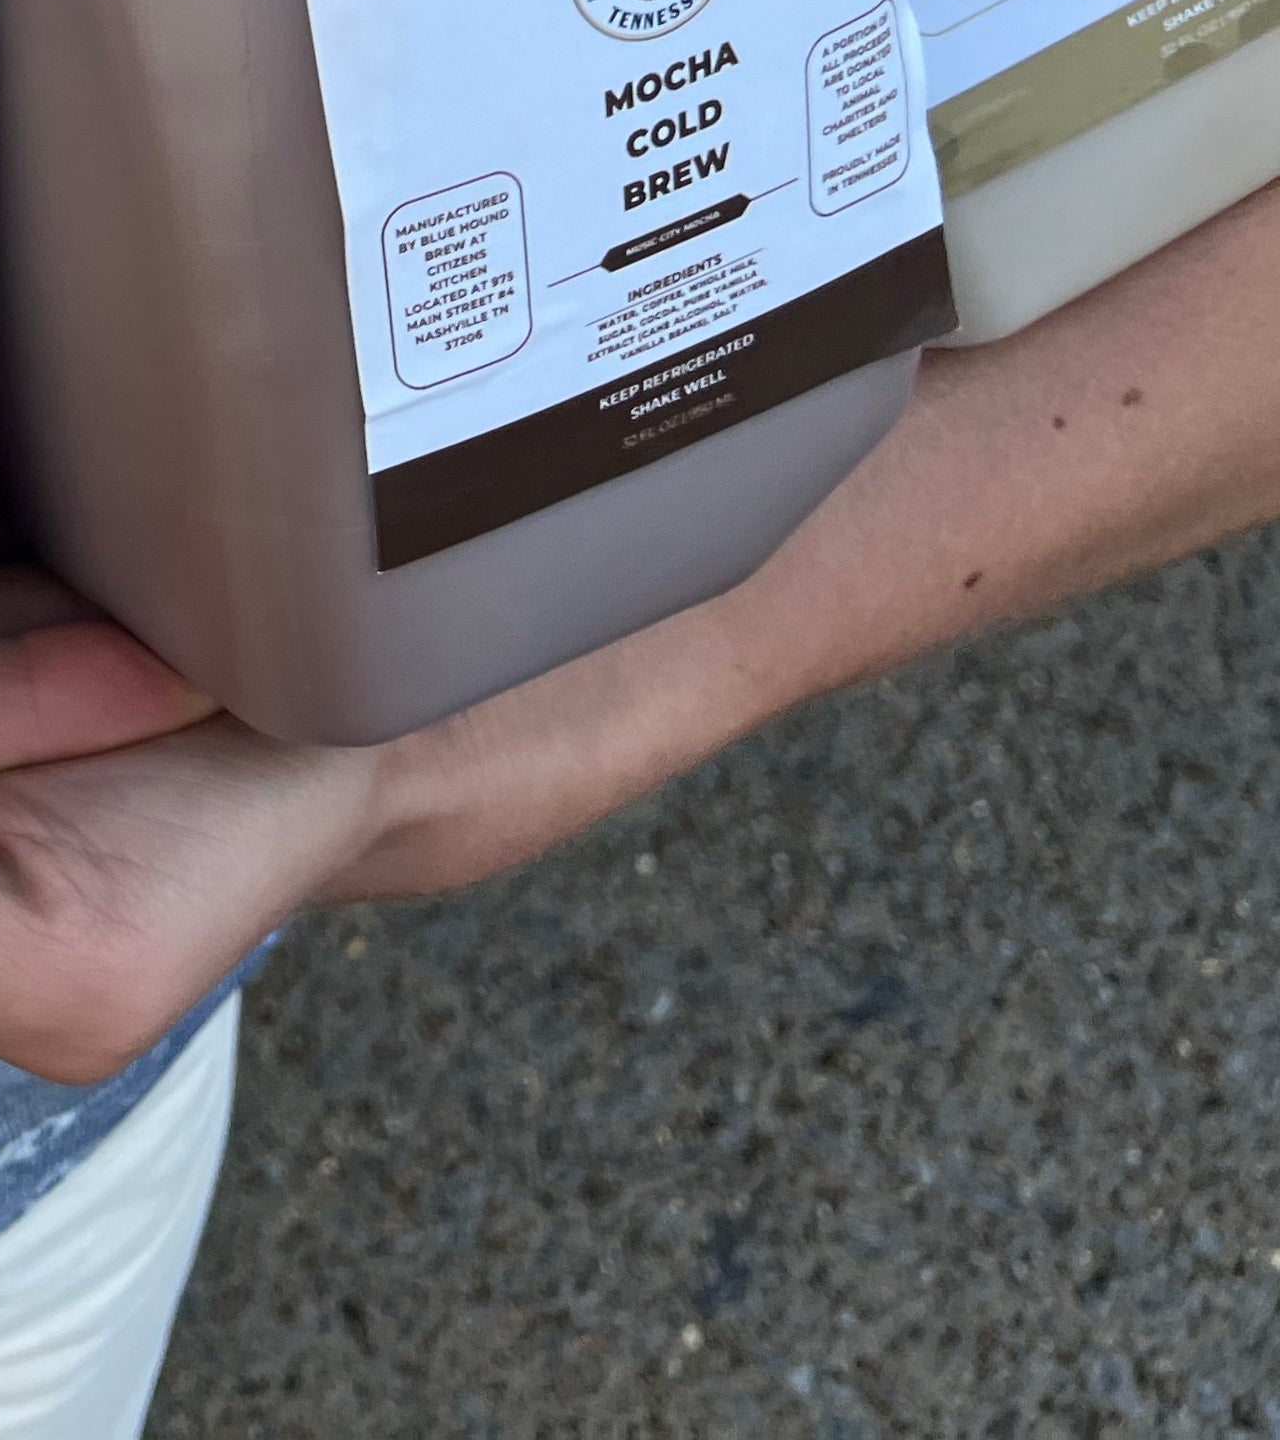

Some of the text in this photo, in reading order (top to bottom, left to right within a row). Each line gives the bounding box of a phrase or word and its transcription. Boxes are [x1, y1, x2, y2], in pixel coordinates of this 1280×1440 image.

[604, 41, 738, 117] MOCHA
[626, 99, 722, 157] COLD
[623, 141, 729, 211] BREW
[628, 253, 721, 302] INGREDIENTS
[599, 333, 753, 409] KEEP REFRIGERATED
[630, 369, 726, 419] SHAKE WELL
